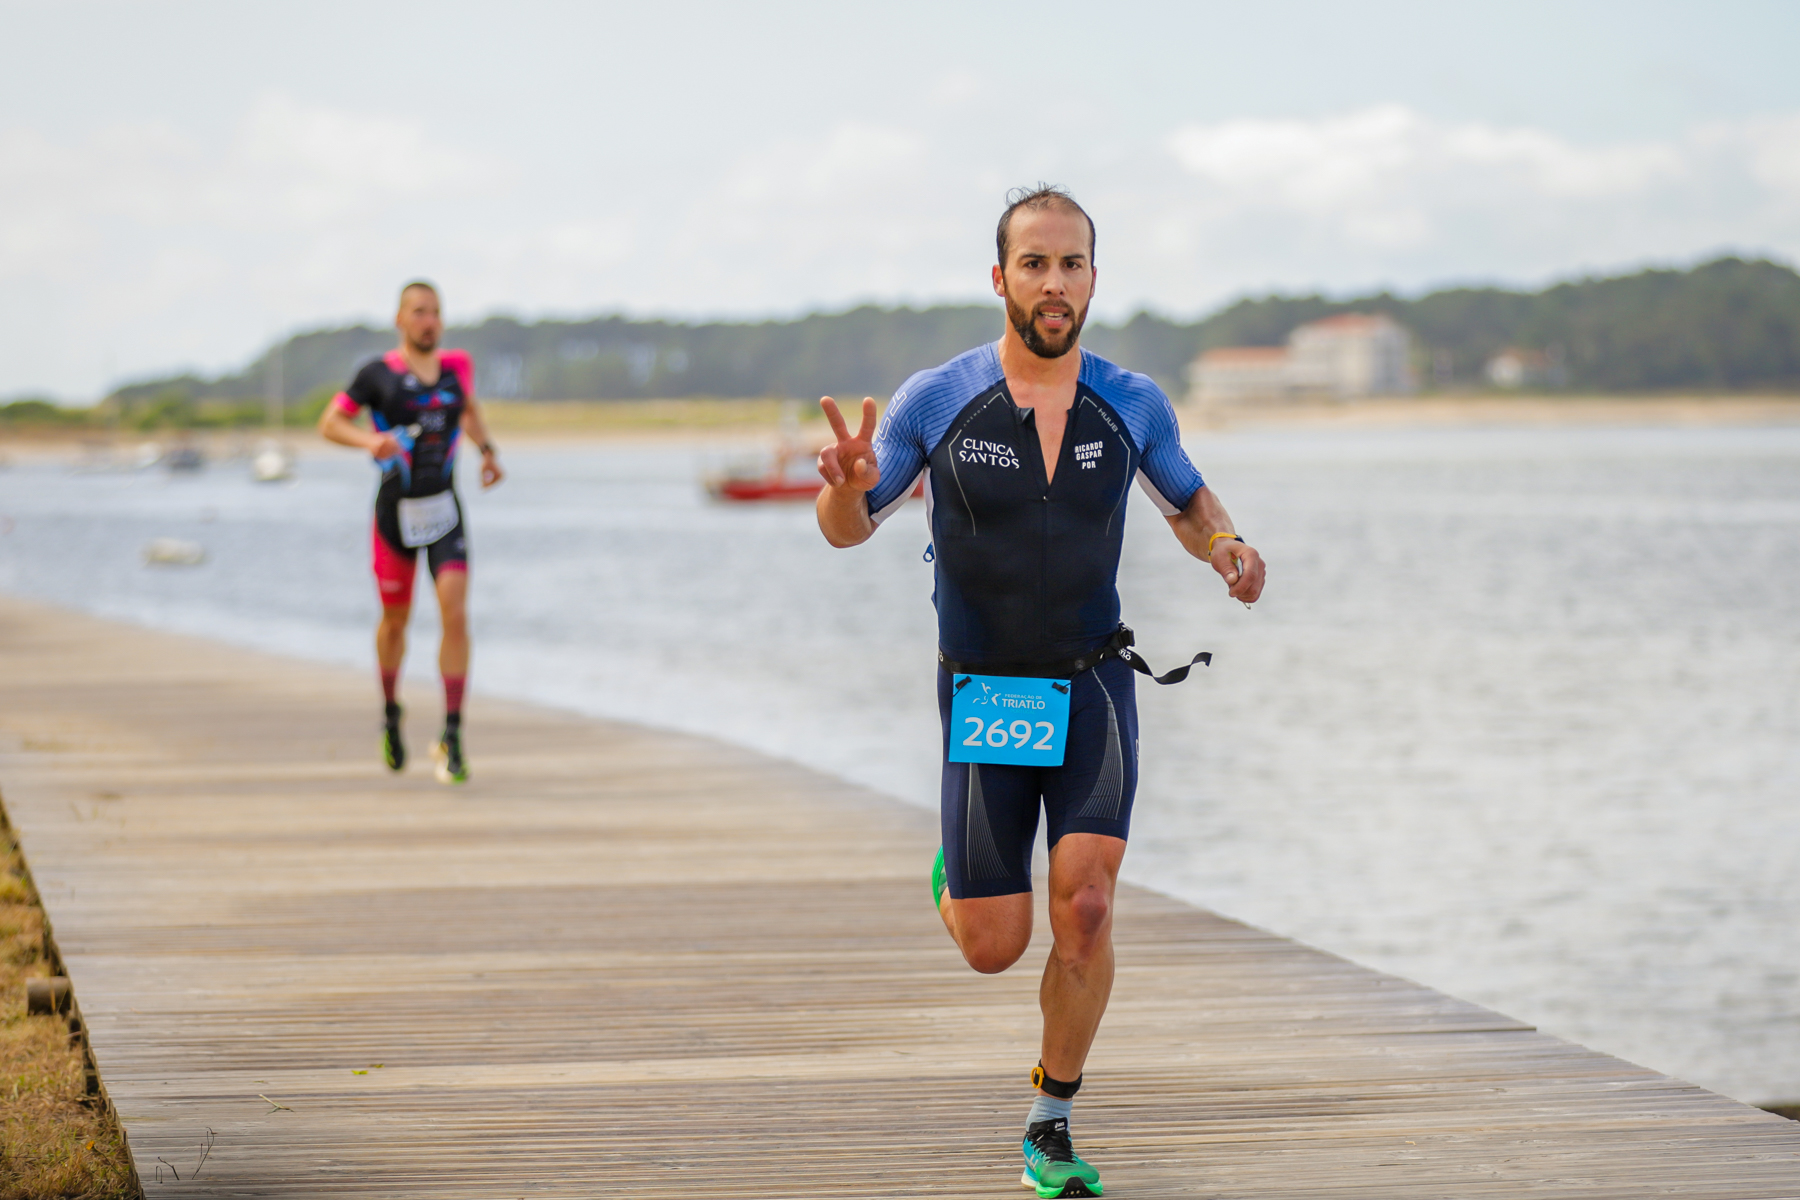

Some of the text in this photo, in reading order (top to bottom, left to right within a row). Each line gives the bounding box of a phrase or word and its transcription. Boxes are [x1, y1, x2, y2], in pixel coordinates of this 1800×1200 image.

[1098, 408, 1119, 433] HUUB
[962, 438, 1016, 457] CLINICA
[1074, 440, 1103, 453] RICARDO
[1076, 449, 1102, 460] GASPAR
[959, 450, 1020, 469] SANTOS
[1082, 460, 1096, 470] POR
[1002, 698, 1046, 710] TRIATLO
[962, 717, 1055, 750] 2692
